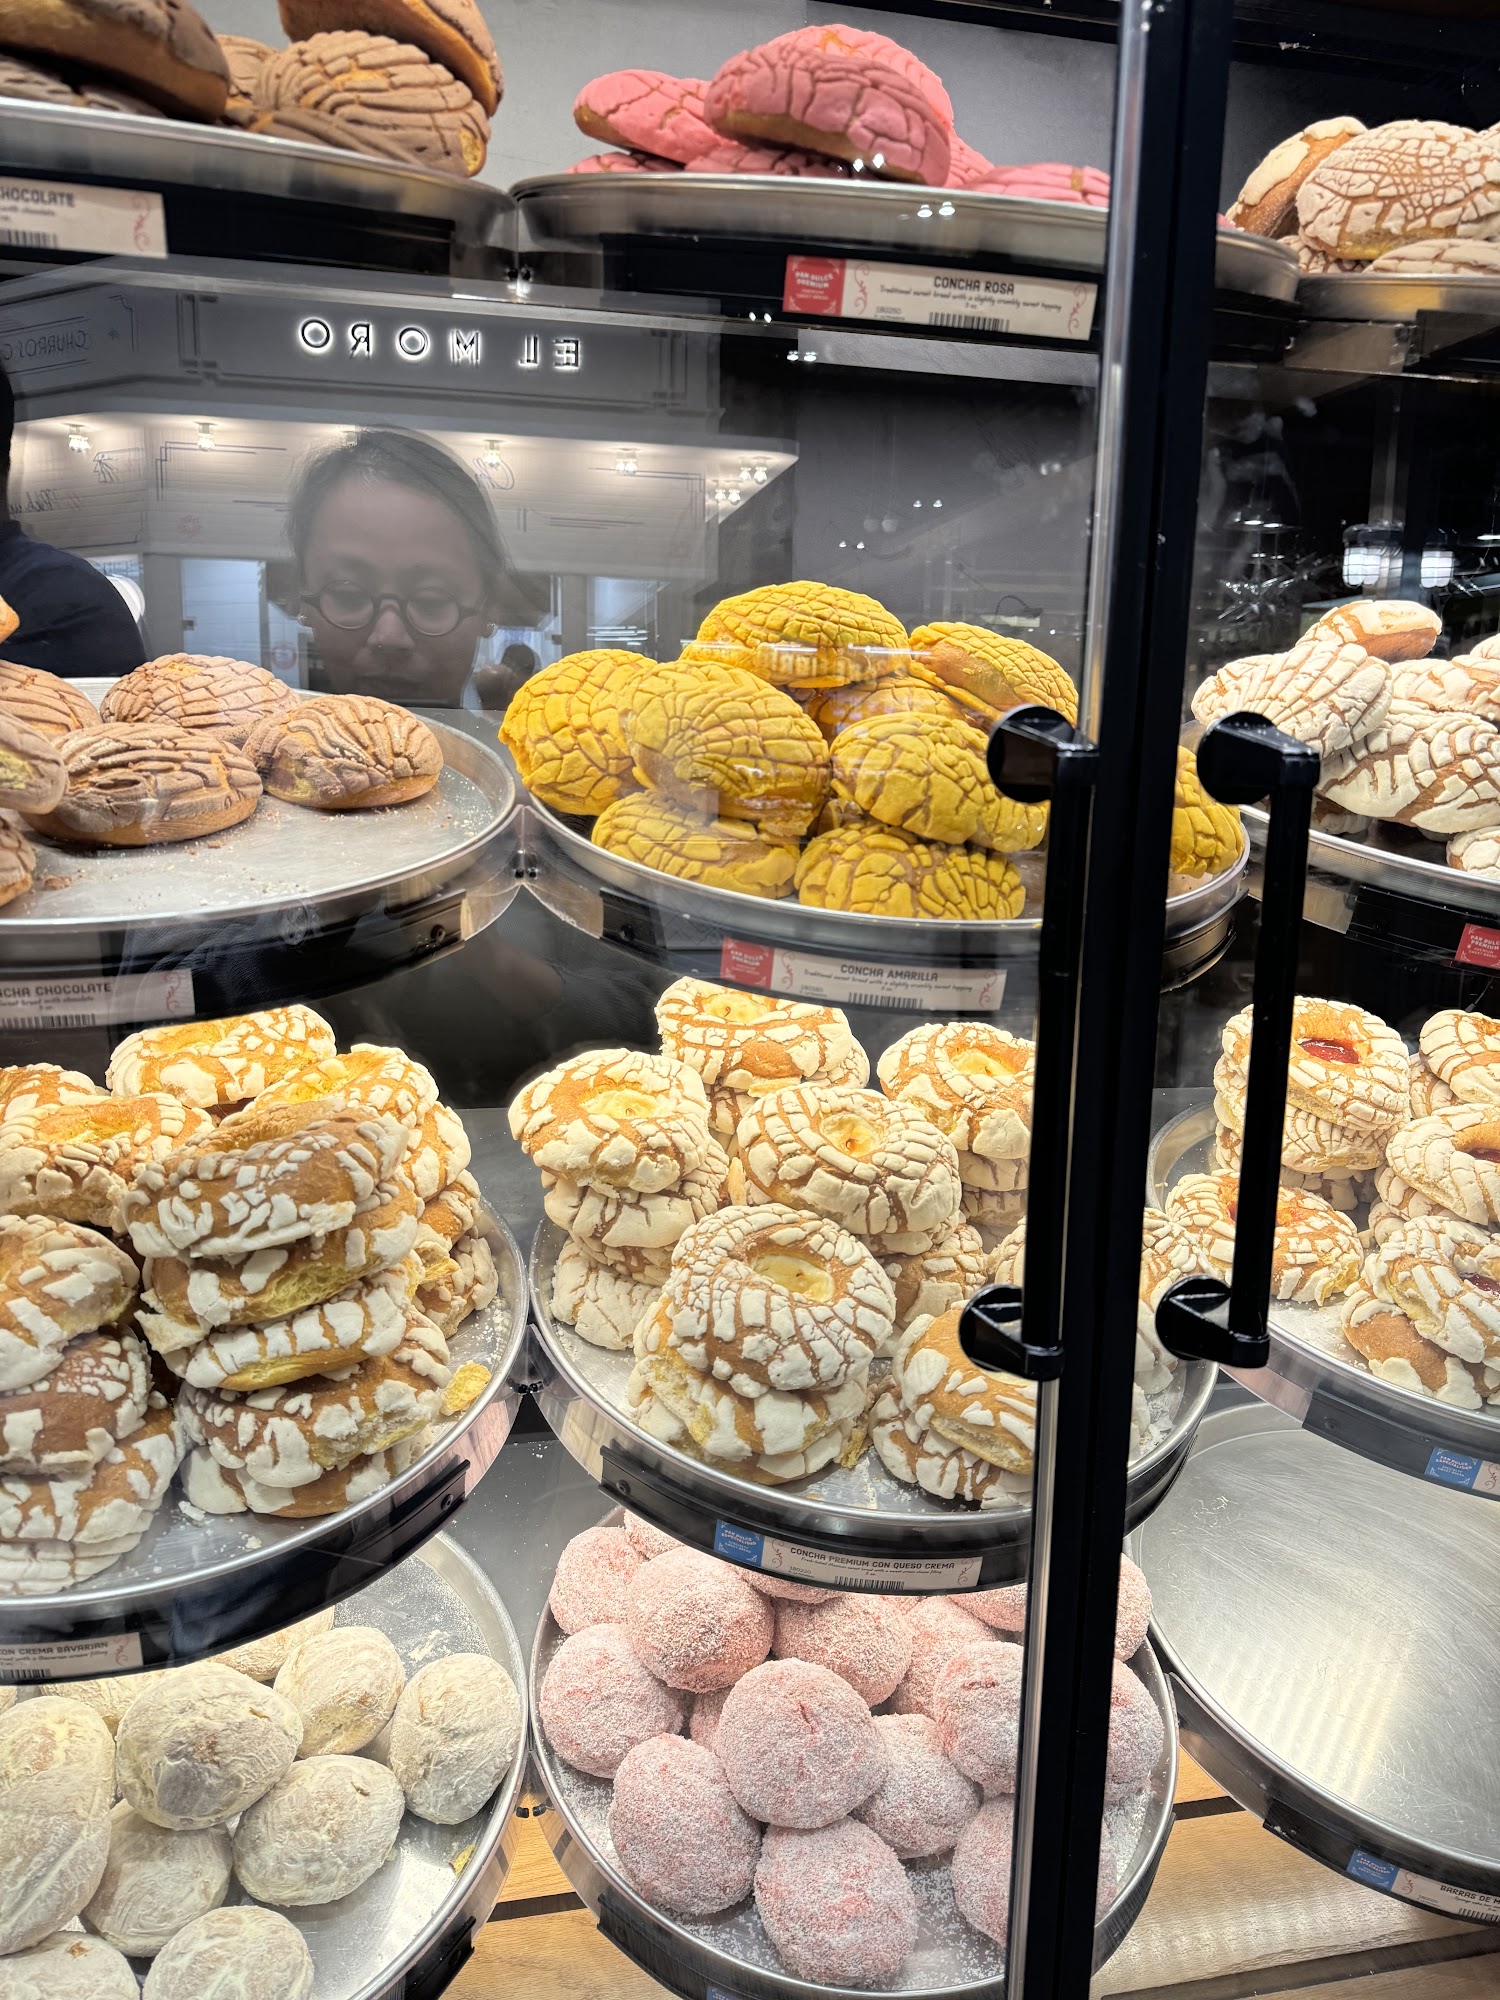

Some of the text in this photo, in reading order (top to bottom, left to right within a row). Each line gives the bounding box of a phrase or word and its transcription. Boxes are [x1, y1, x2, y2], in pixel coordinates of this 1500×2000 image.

[0, 187, 75, 208] HOCOLATE
[934, 276, 1015, 295] CONCHA ROSA
[1471, 939, 1500, 950] PREMIUM
[1484, 938, 1500, 946] DULC
[841, 964, 938, 981] CONCHA AMARILLA
[0, 983, 111, 998] CHA CHOCOLATE
[791, 1547, 826, 1560] CONCHA
[829, 1555, 869, 1567] PREMIUM
[19, 1647, 53, 1655] CREMA
[1440, 1884, 1477, 1900] BARRAS
[1479, 1894, 1492, 1903] DE
